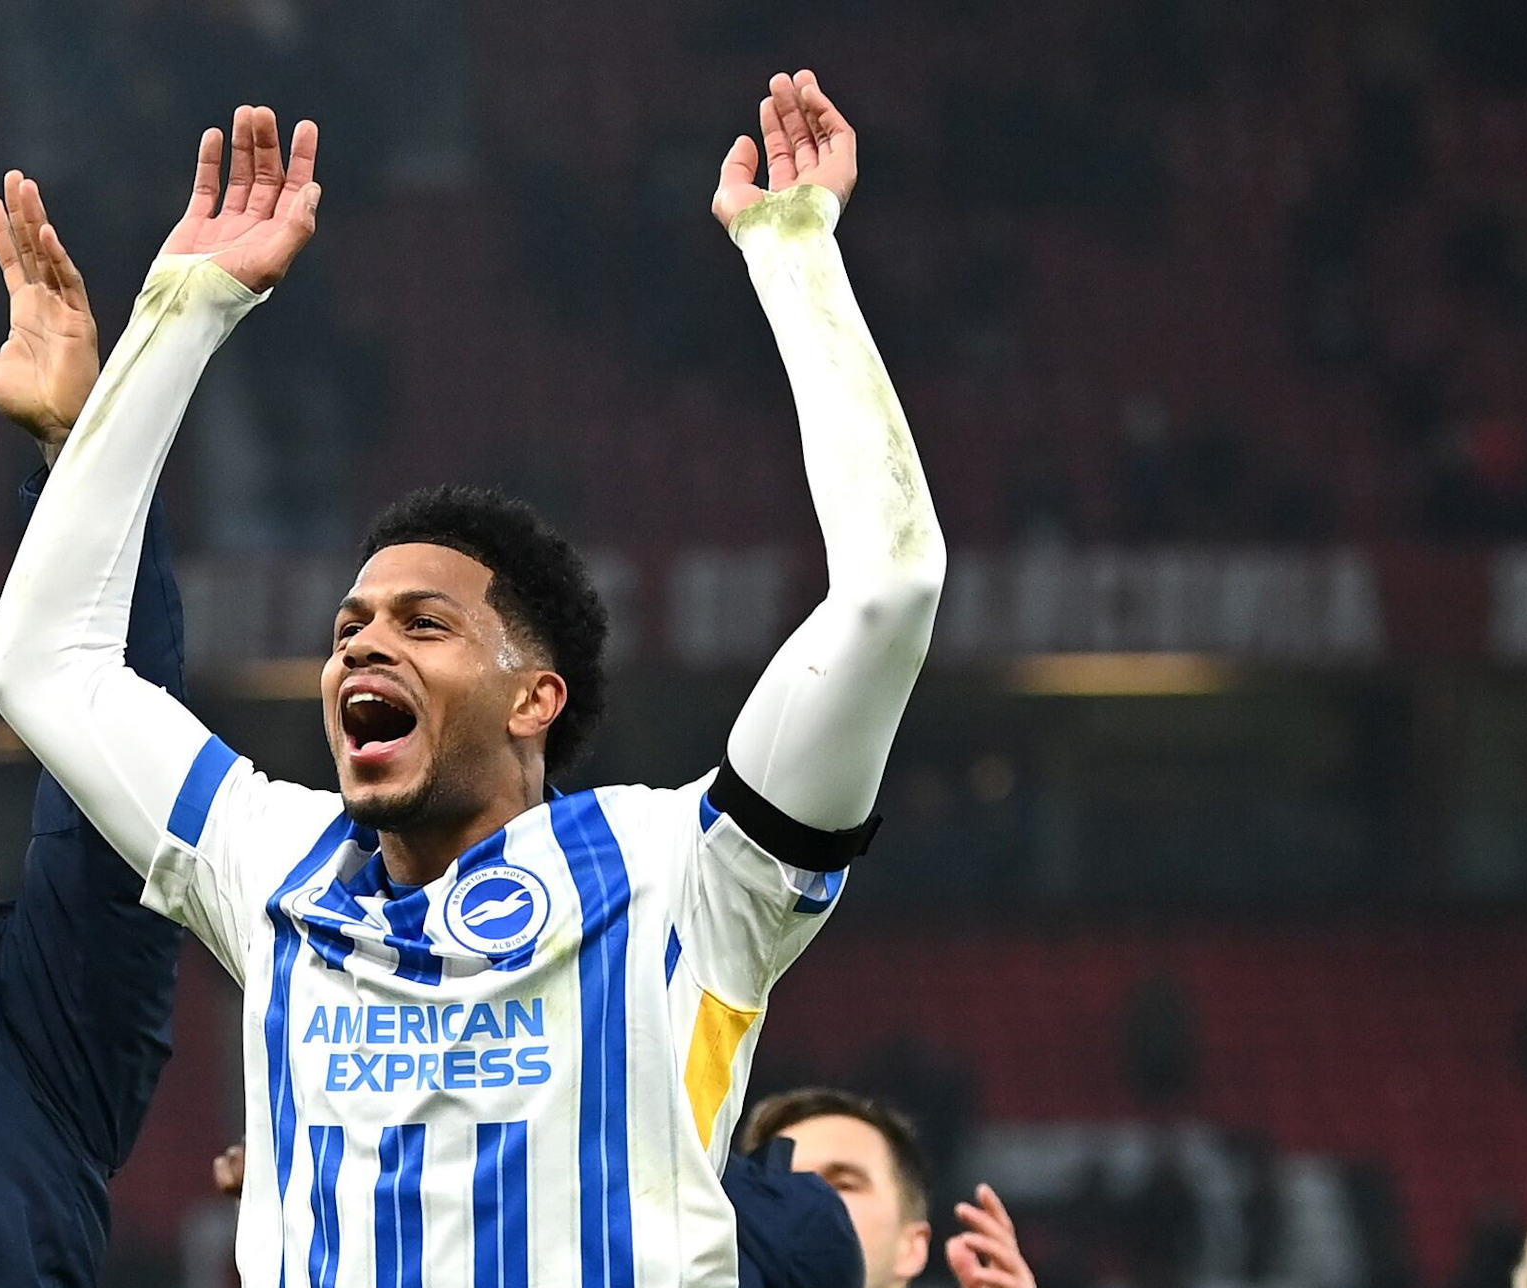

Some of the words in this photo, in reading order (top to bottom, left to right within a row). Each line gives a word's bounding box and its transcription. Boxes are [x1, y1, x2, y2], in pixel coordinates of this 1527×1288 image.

[491, 934, 528, 950] ALBION
[302, 998, 544, 1044] AMERICAN
[325, 1046, 552, 1093] EXPRESS
